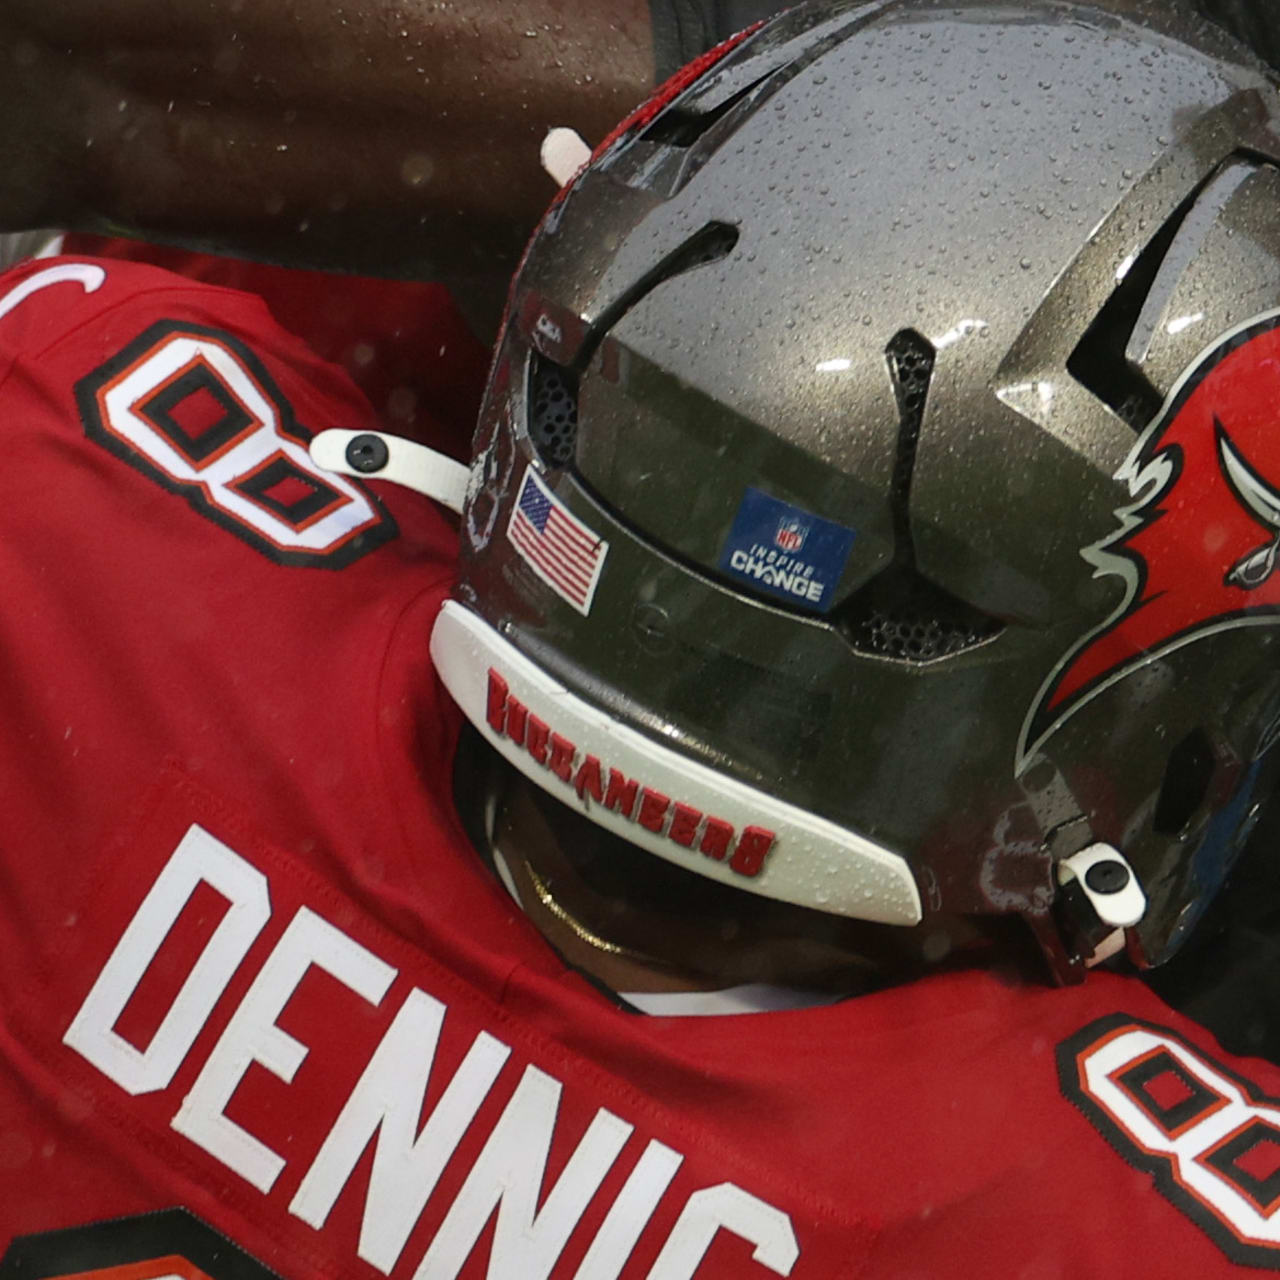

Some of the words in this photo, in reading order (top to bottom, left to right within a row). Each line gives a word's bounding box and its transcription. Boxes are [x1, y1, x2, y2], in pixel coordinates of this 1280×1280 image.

[75, 318, 400, 570] 8
[730, 549, 825, 603] CHANGE
[750, 543, 816, 579] INSPIRE
[486, 666, 776, 877] BUCCANEERS
